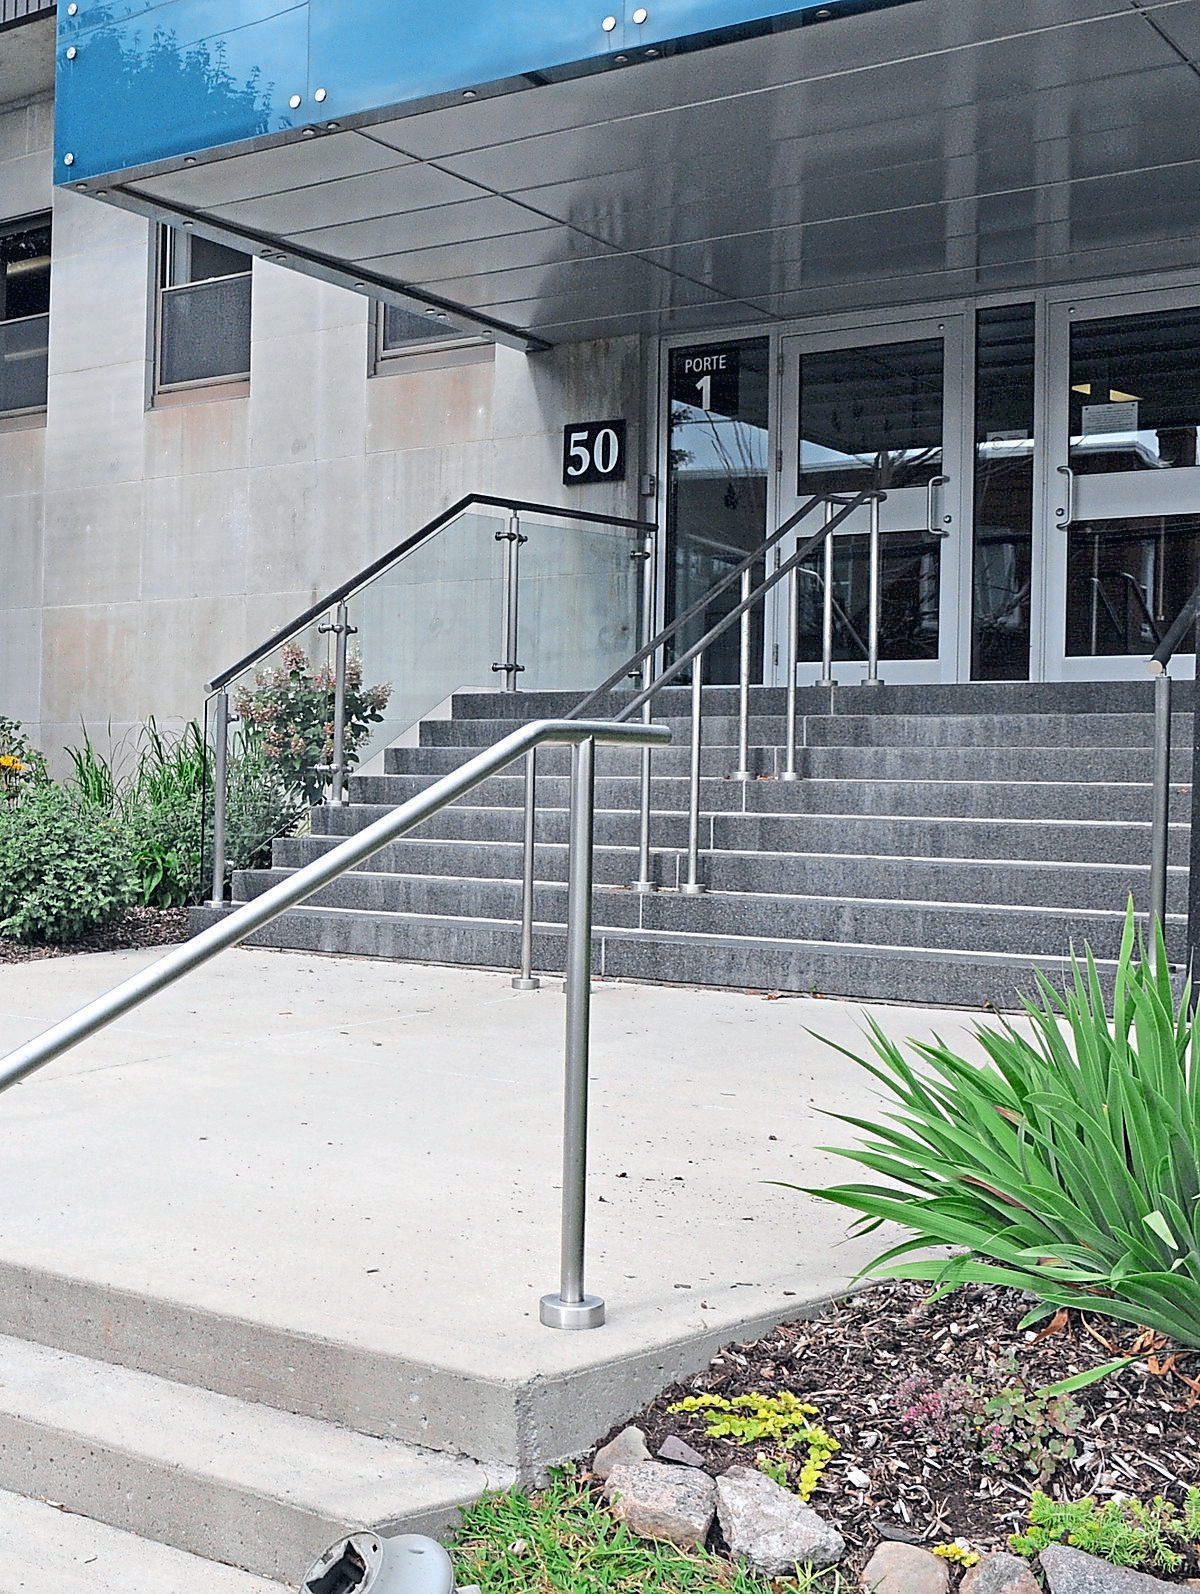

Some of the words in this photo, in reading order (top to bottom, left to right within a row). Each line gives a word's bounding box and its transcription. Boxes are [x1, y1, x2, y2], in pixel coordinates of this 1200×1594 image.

[685, 355, 727, 373] PORTE
[696, 375, 711, 411] 1
[567, 428, 619, 475] 50
